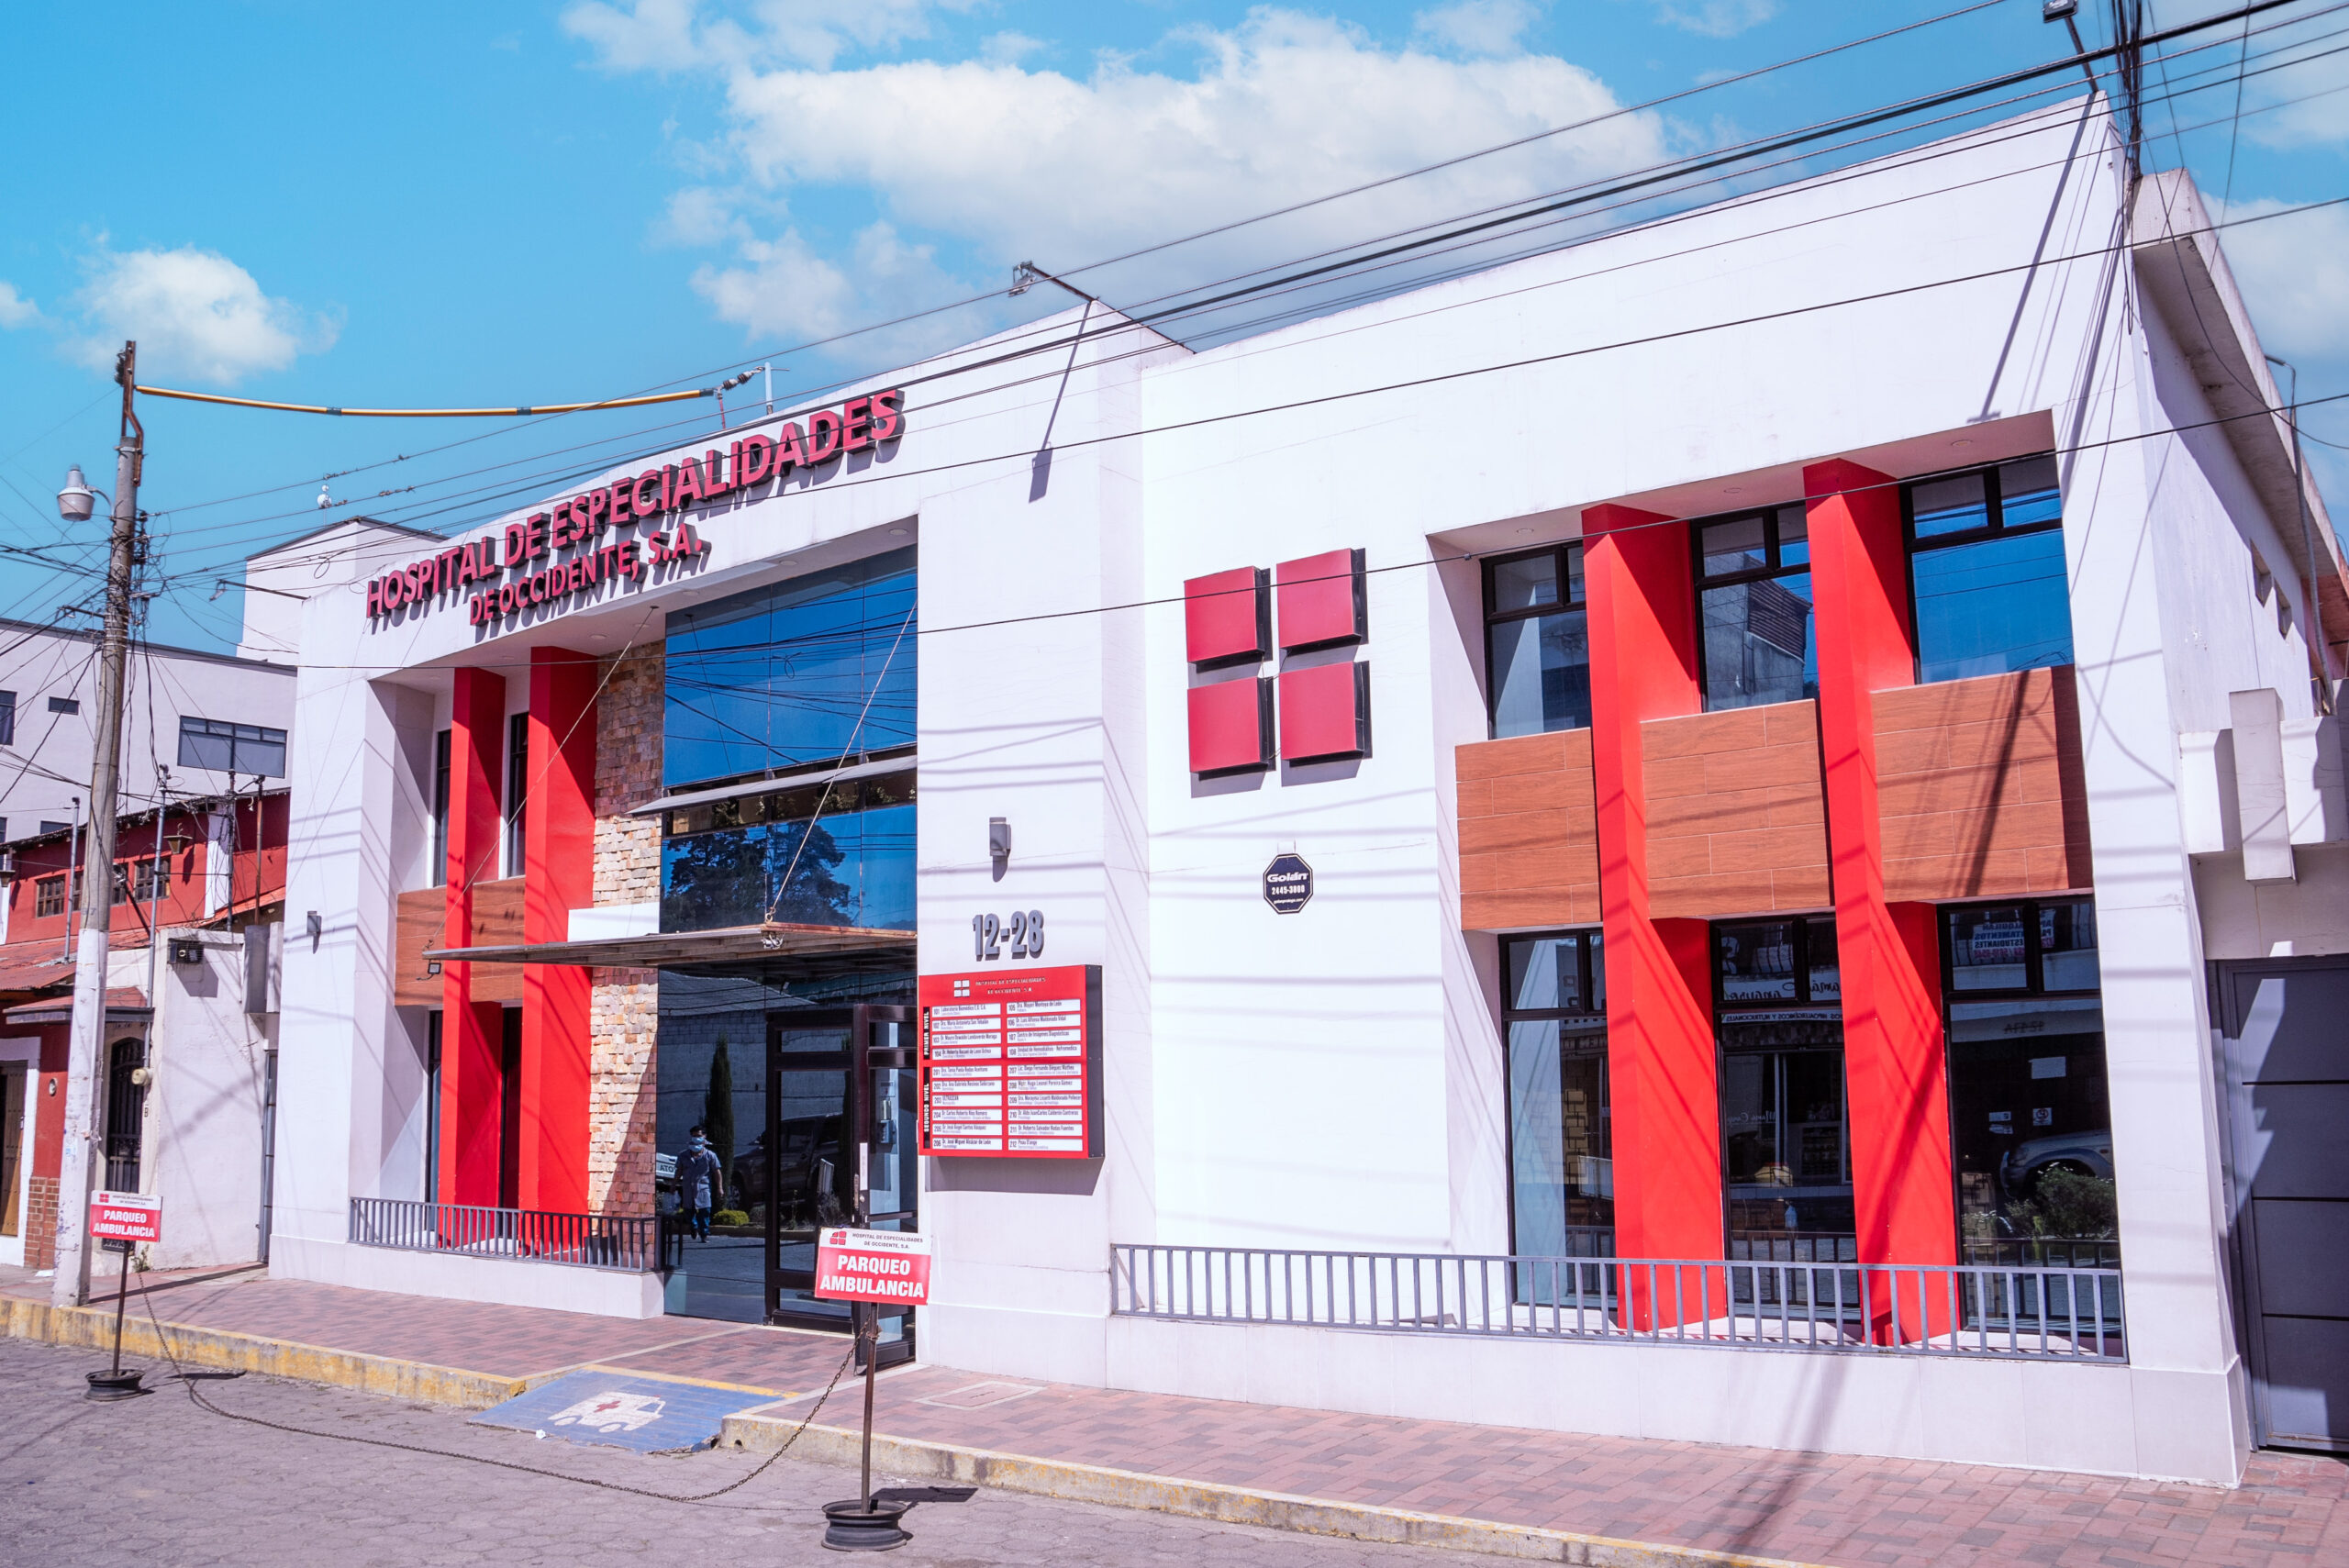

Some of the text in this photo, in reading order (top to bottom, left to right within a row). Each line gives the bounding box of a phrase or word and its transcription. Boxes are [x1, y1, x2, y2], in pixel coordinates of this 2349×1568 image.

[366, 388, 903, 619] HOSPITAL DE ESPECIALIDADES
[471, 594, 495, 626] DE
[648, 523, 704, 566] S.A.
[972, 909, 1044, 960] 12-28
[104, 1209, 147, 1223] PARQUEO
[93, 1222, 155, 1238] AMBULANCIA
[884, 1235, 923, 1243] ESPECIALIDADES
[837, 1254, 910, 1275] PARQUEO
[819, 1274, 925, 1298] AMBULANCIA
